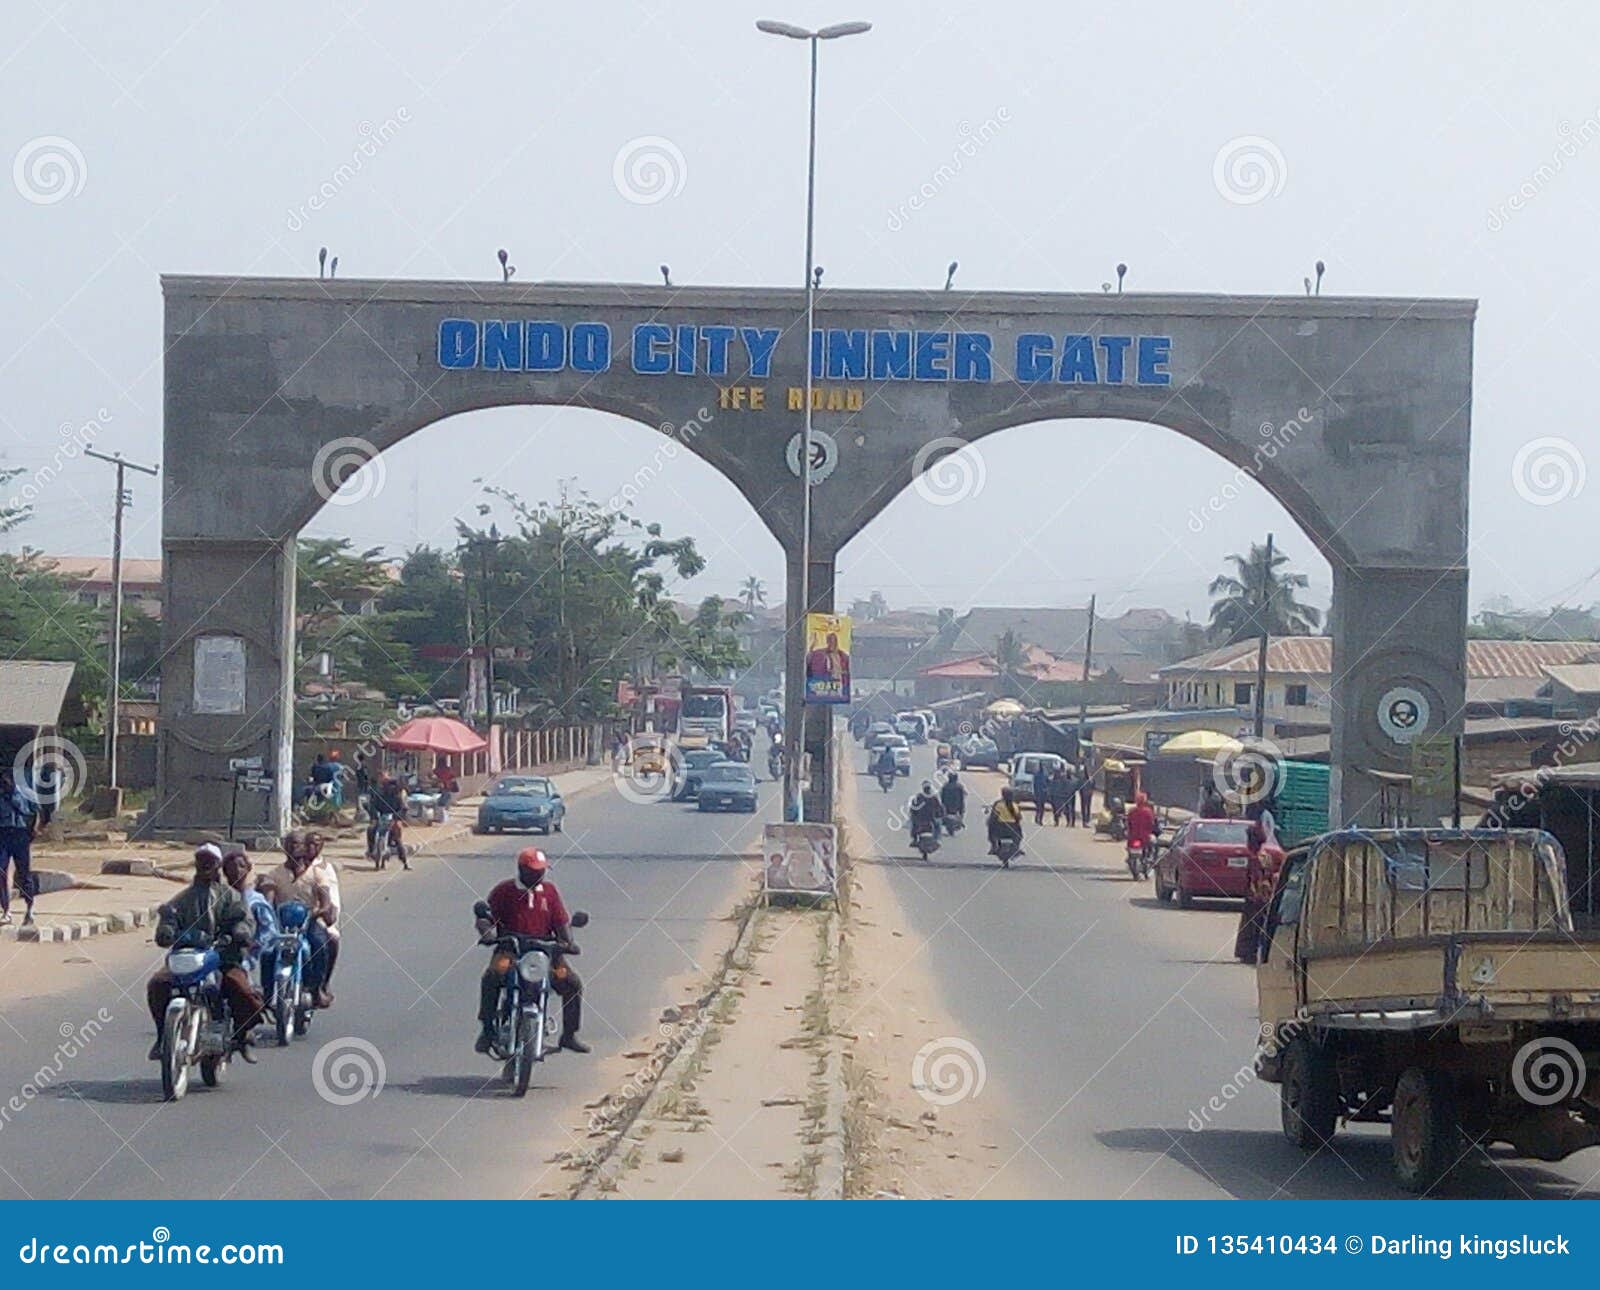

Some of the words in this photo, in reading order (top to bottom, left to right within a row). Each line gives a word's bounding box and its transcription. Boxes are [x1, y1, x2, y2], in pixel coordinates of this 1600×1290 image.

[437, 319, 612, 373] ONDO
[631, 322, 783, 378] CITY
[810, 328, 994, 382] INNER
[1014, 332, 1173, 386] GATE
[719, 386, 765, 410] IFE
[787, 386, 865, 412] ROAD
